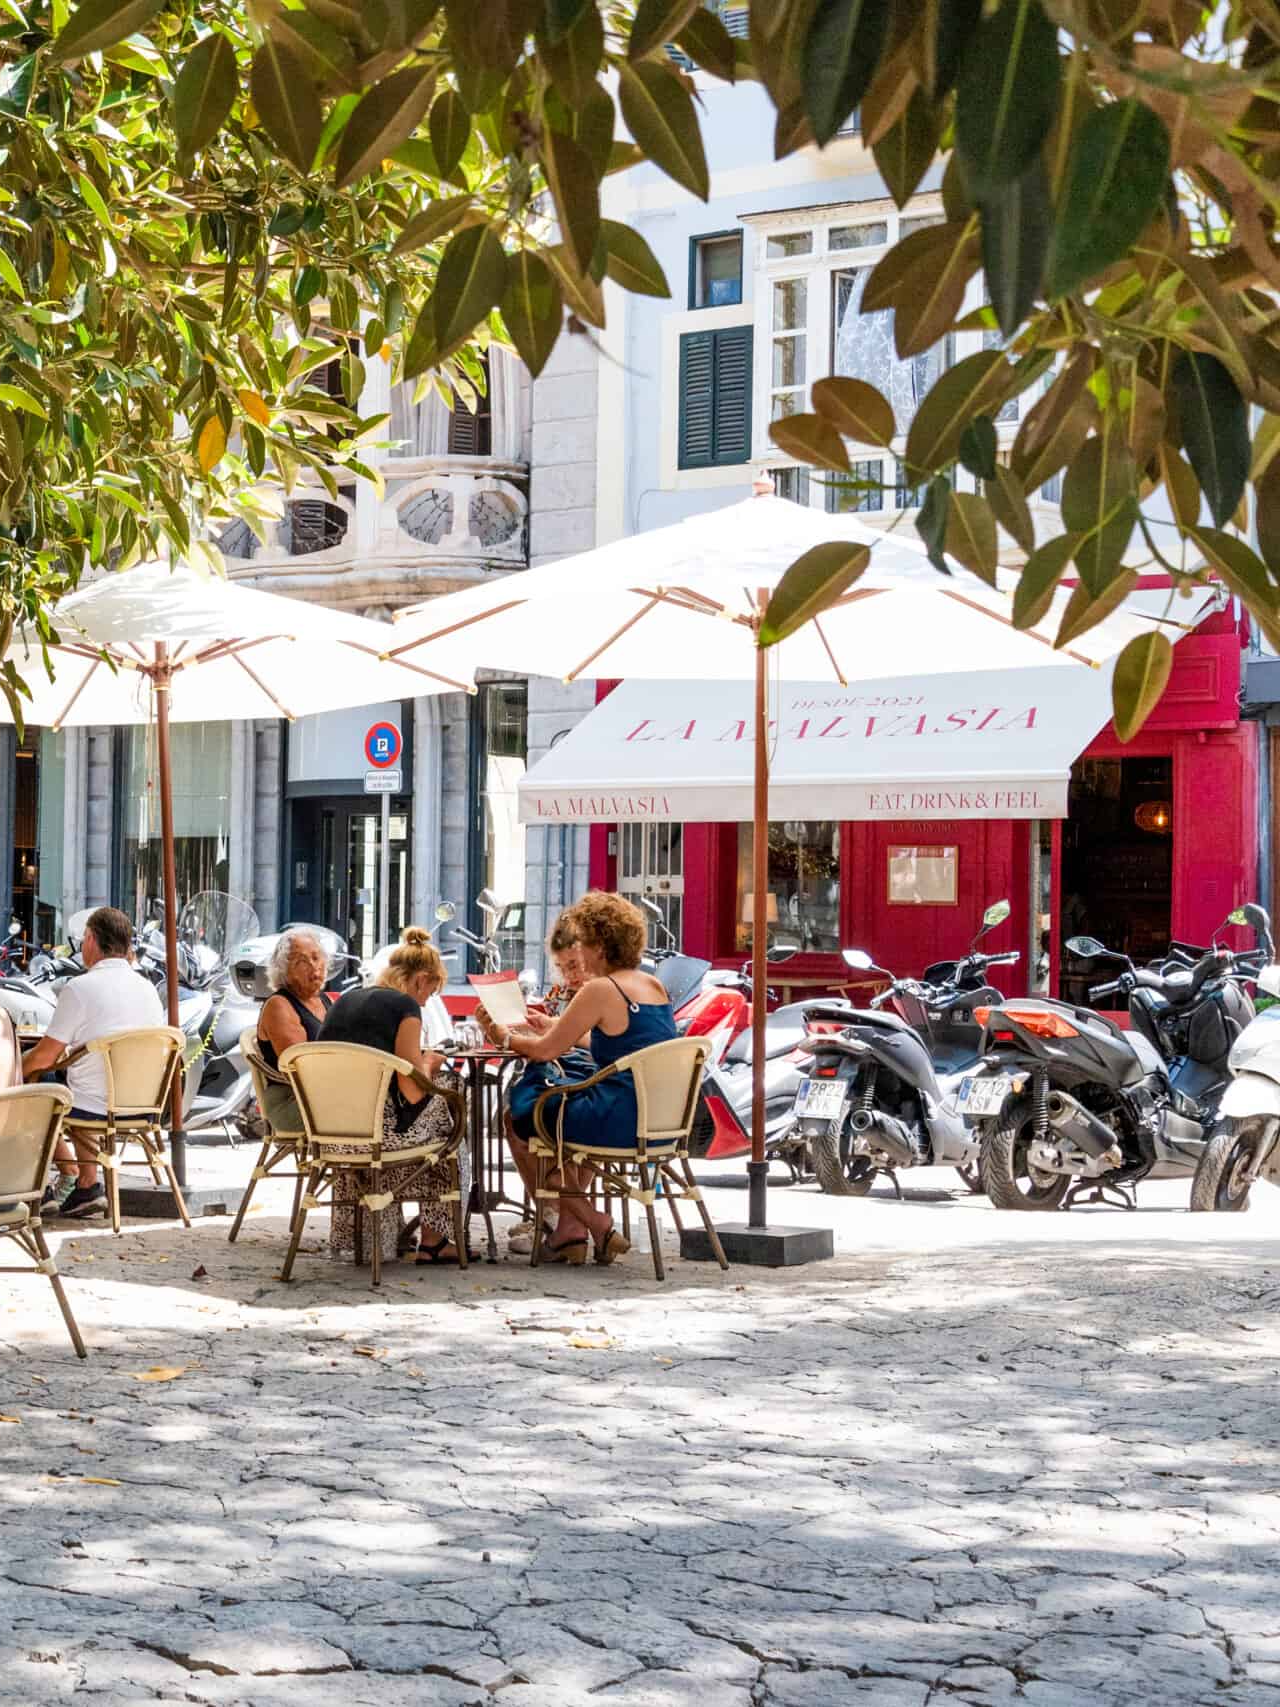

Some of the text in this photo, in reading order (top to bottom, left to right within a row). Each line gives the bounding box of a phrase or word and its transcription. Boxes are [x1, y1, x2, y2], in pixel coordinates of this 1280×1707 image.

[621, 706, 1039, 742] LA MALVASIA
[536, 795, 672, 817] LA MALVASIA
